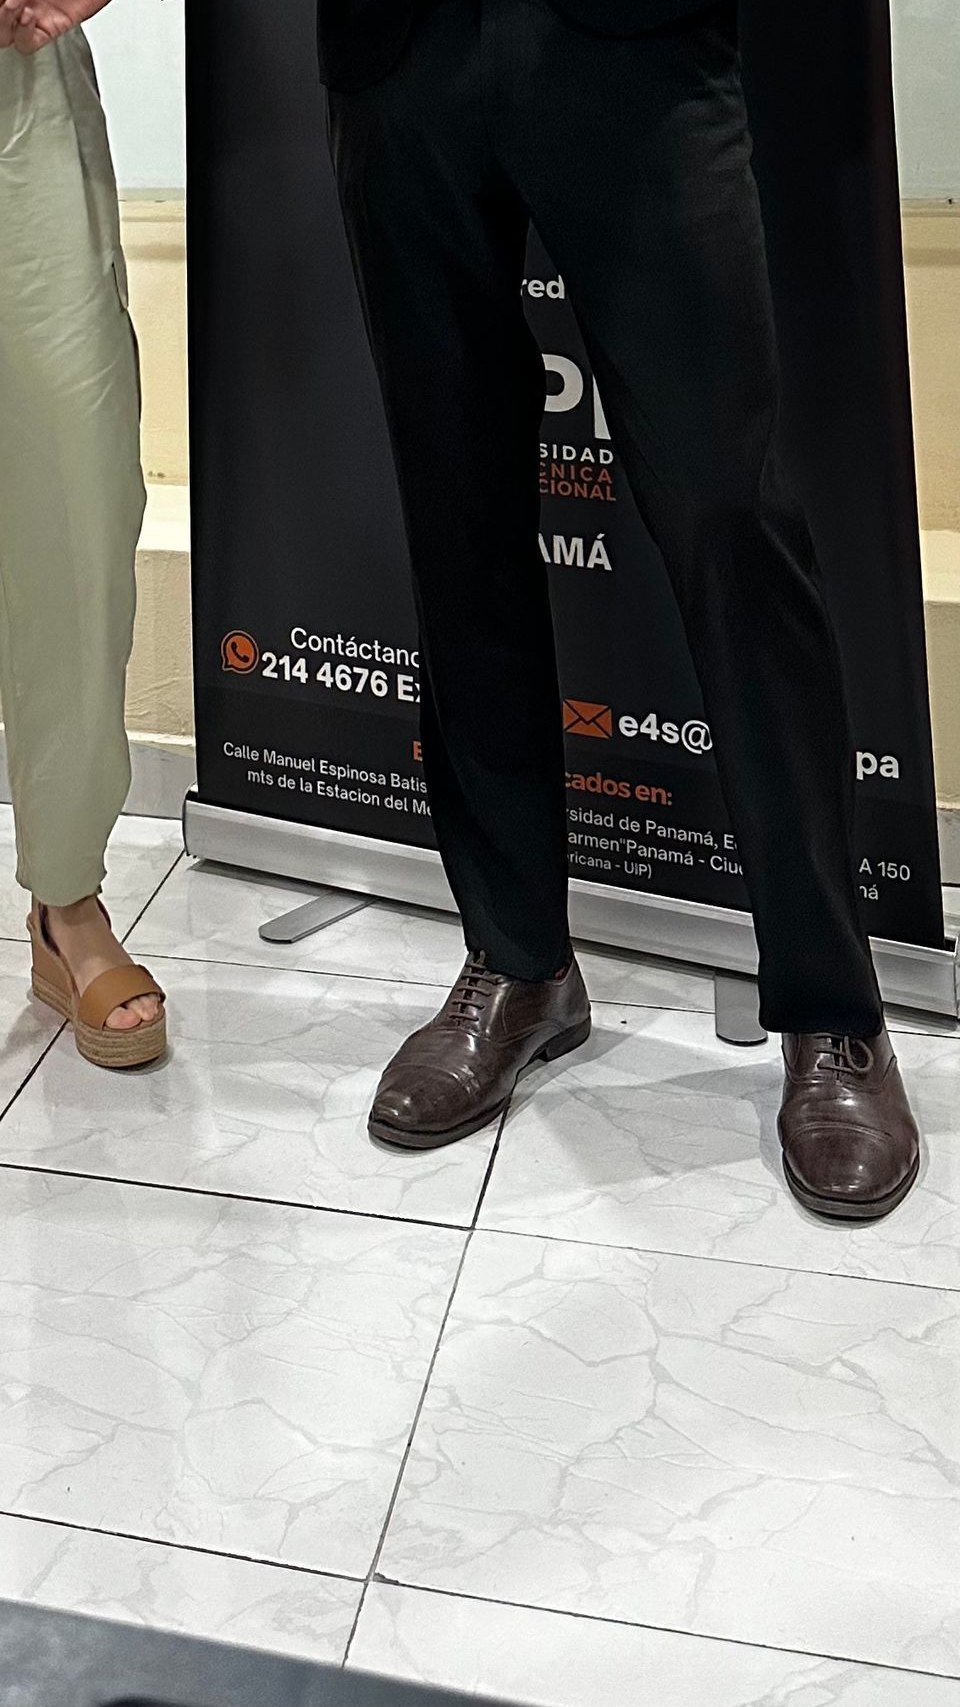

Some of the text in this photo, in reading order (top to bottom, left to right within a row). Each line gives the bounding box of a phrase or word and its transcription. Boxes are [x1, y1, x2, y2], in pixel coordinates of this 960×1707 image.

[261, 651, 308, 684] 214
[316, 662, 388, 698] 4676
[223, 741, 260, 761] Calle
[263, 749, 316, 773] Manuel
[319, 759, 386, 786] Espinosa
[247, 769, 274, 786] mts
[277, 774, 295, 790] de
[299, 777, 313, 794] la
[317, 781, 380, 807] Estacion
[384, 795, 408, 812] del
[635, 783, 672, 806] en:
[619, 816, 640, 833] de
[645, 820, 719, 850] Panamá,
[877, 861, 910, 881] 150
